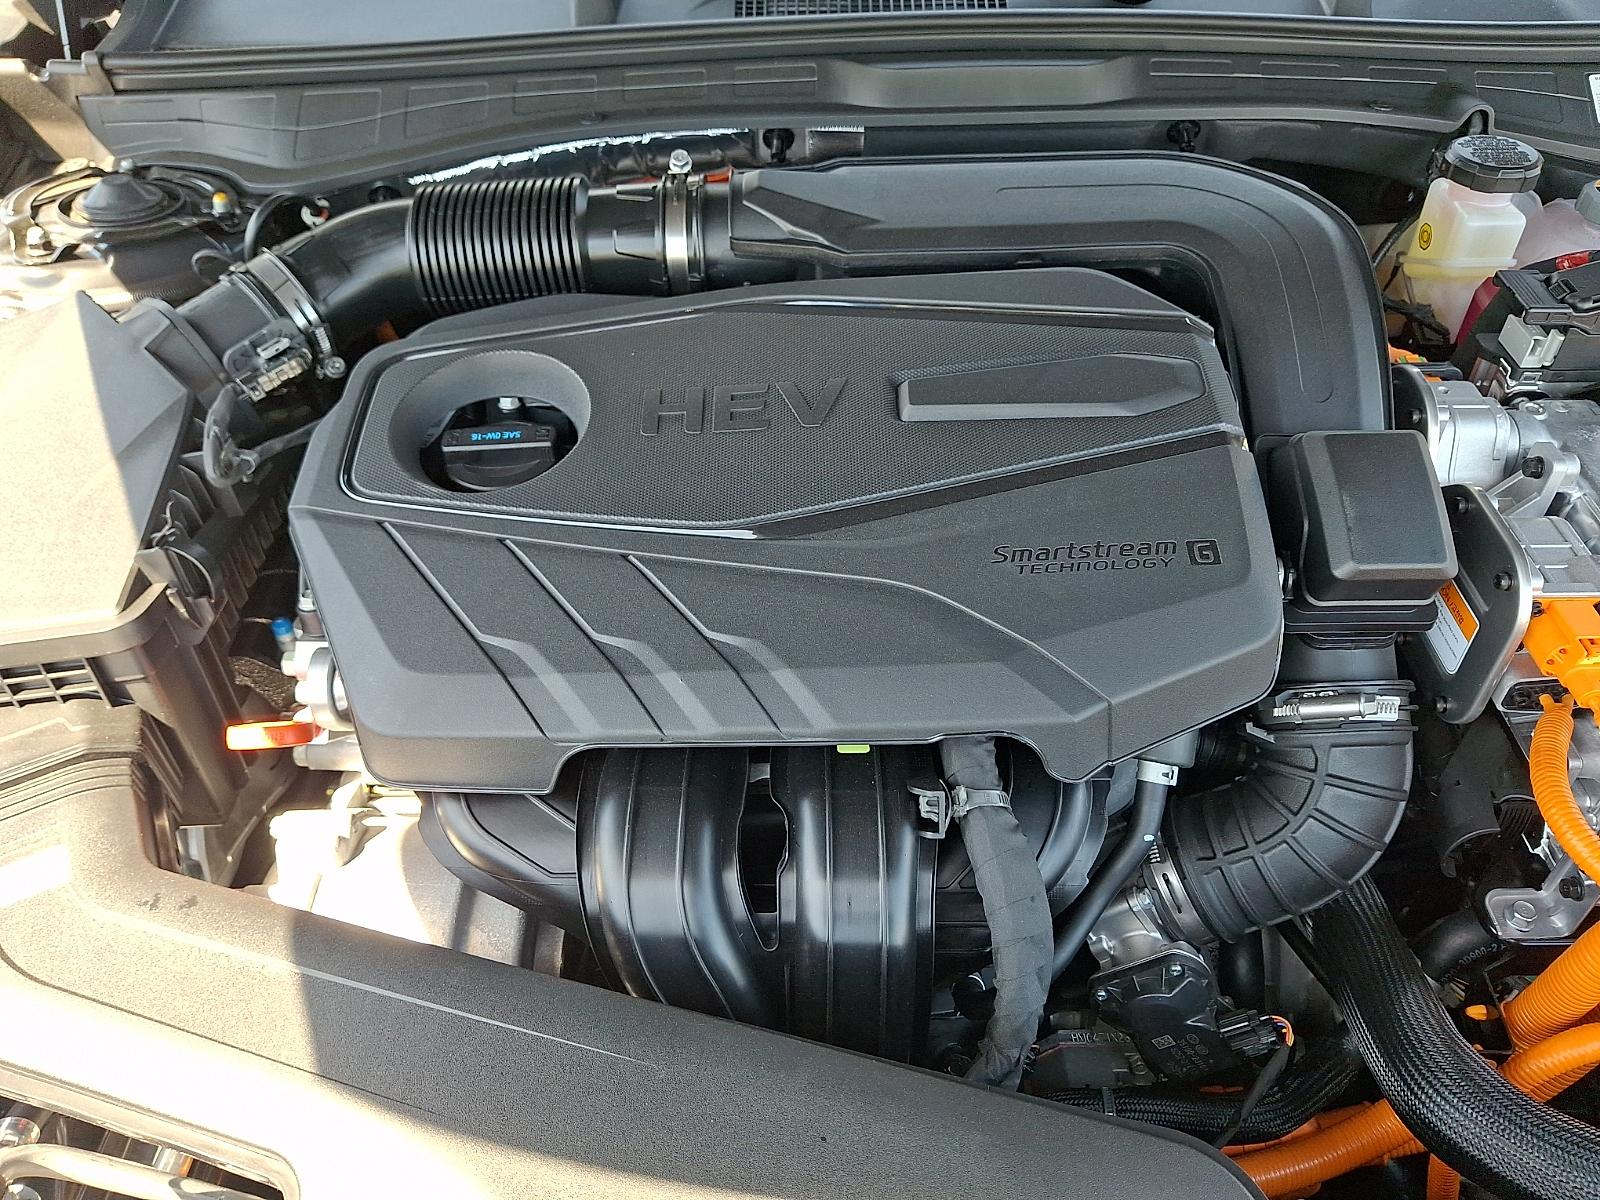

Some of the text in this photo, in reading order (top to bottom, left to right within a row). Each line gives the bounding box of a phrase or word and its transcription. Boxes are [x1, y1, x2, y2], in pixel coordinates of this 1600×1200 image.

[640, 377, 848, 436] HEV
[502, 431, 521, 439] SAE
[991, 540, 1177, 563] Smartstream
[1015, 557, 1175, 575] TECHNOLOGY
